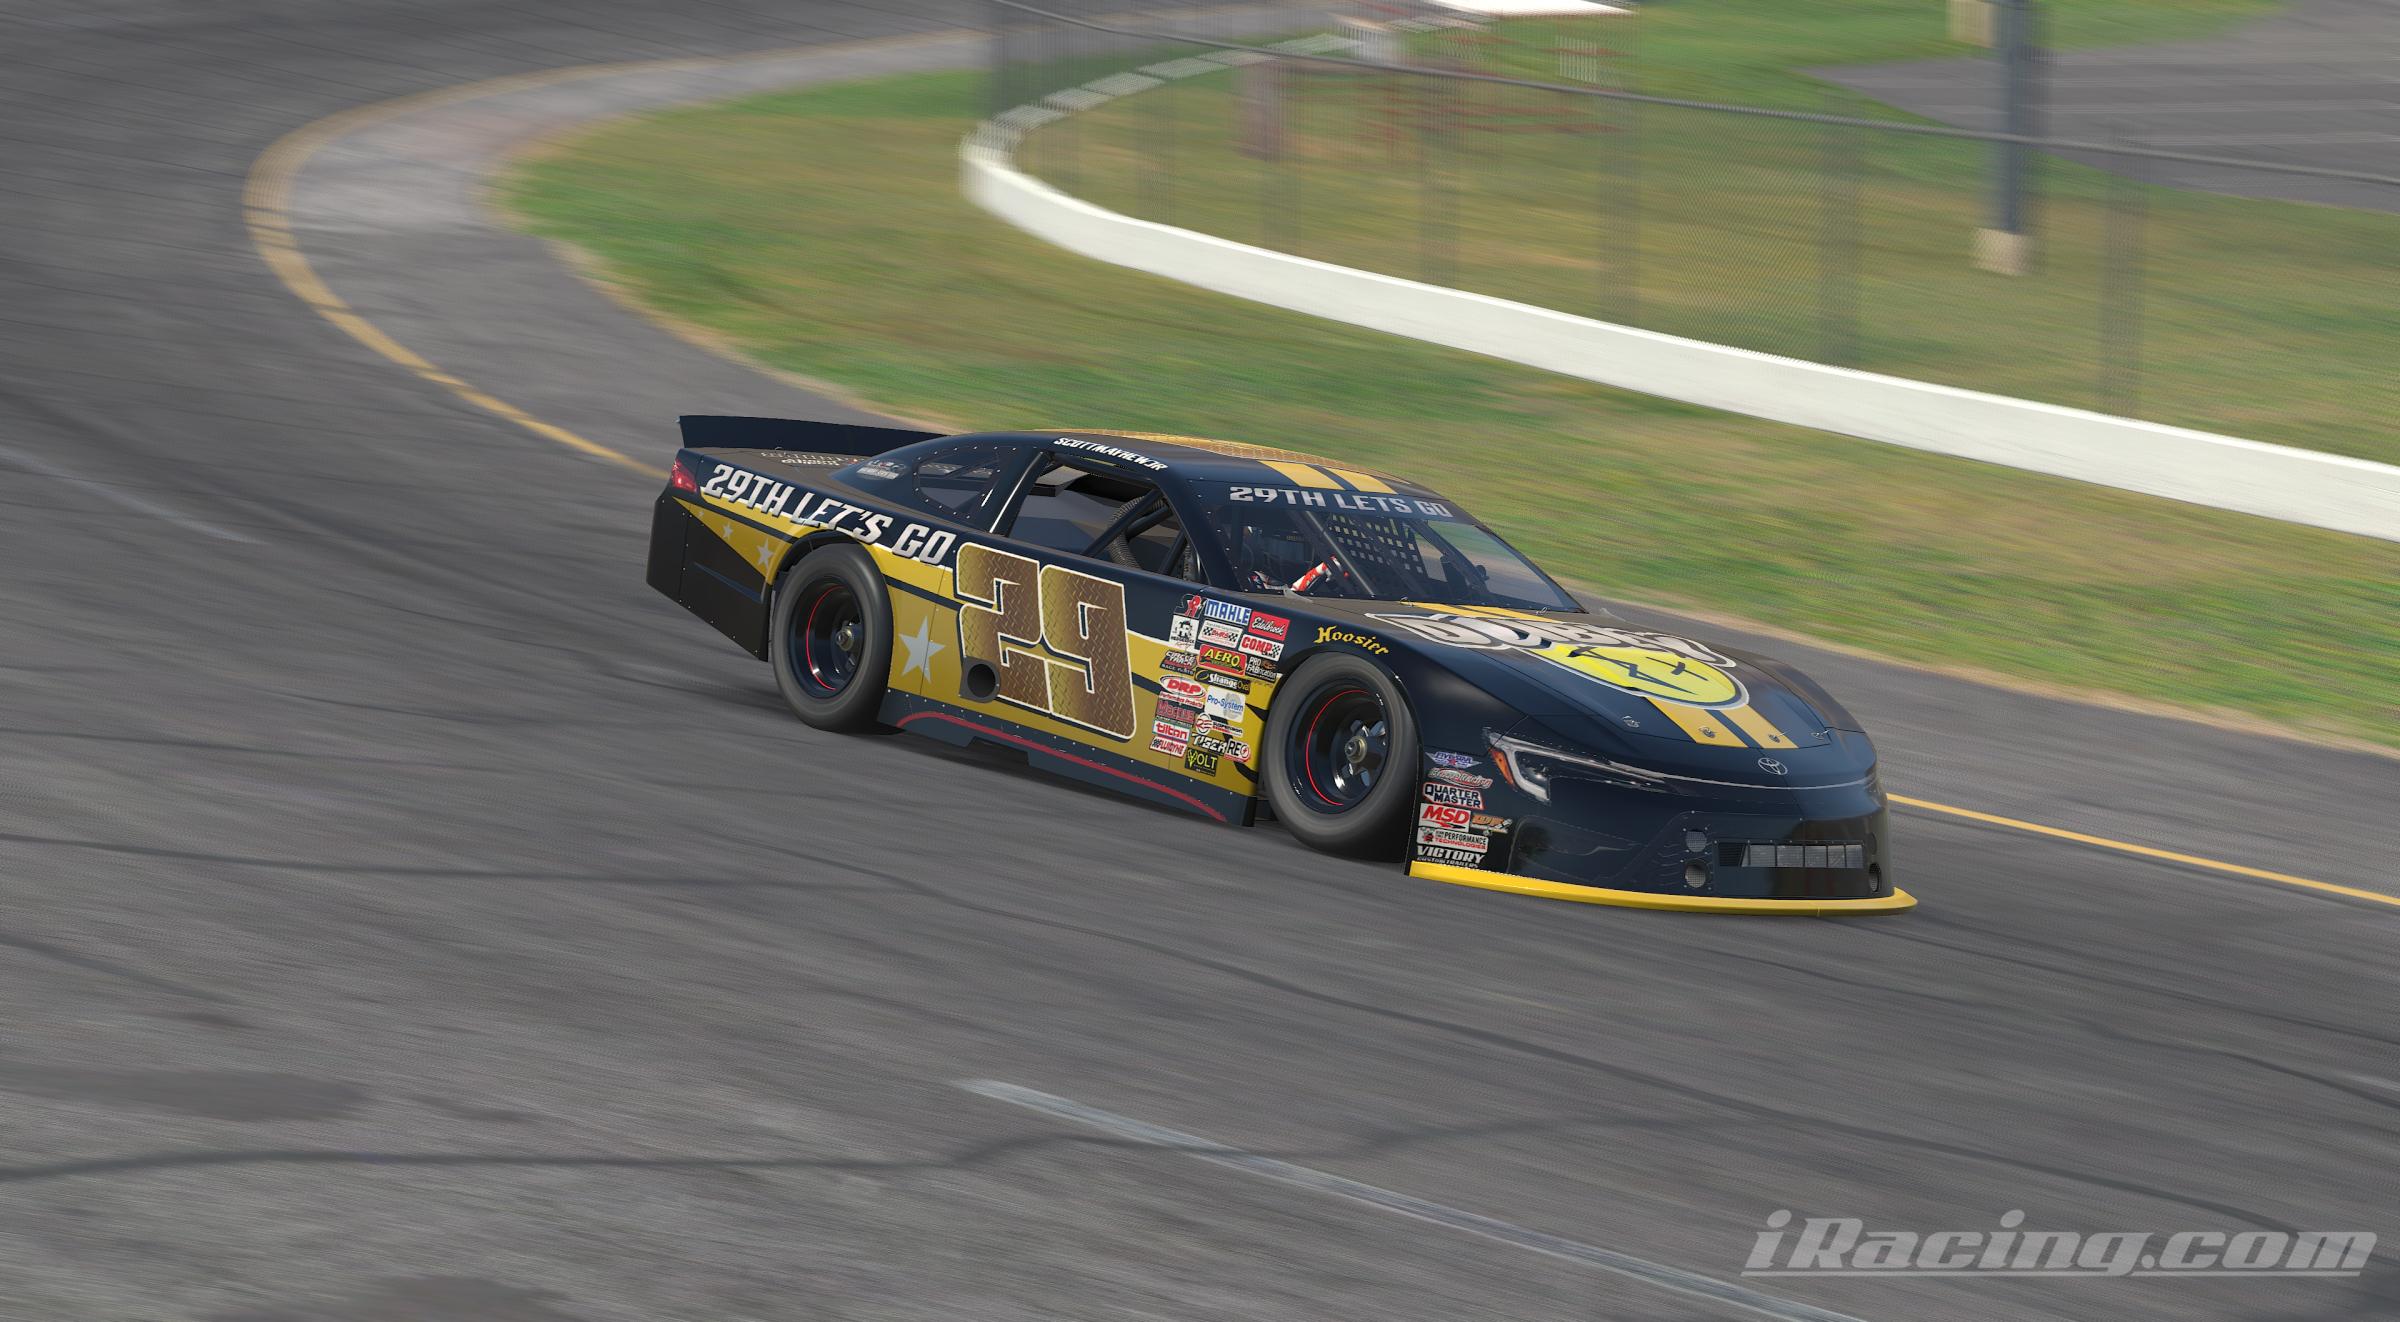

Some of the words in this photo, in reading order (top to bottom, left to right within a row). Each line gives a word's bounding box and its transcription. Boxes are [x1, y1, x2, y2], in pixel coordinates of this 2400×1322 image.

[1230, 486, 1326, 507] 29TH
[1333, 493, 1412, 513] LETS
[1413, 500, 1453, 518] GO
[704, 464, 795, 517] 29TH
[790, 492, 894, 544] LET'S
[892, 523, 957, 564] GO
[1206, 600, 1251, 625] MAHLE
[1252, 616, 1285, 636] Edelbrock
[956, 542, 1136, 739] 29
[1241, 636, 1273, 655] COMP
[1313, 625, 1389, 655] Hoosier
[1204, 648, 1241, 668] AERO
[1249, 656, 1261, 667] PRO
[1167, 678, 1202, 695] DRP
[1208, 673, 1238, 691] Strange
[1206, 694, 1244, 713] Pro-System
[1156, 722, 1188, 740] tilton
[1425, 783, 1480, 800] QUARTER
[1434, 792, 1481, 808] MASTER
[1422, 805, 1470, 824] MSD
[1435, 838, 1487, 850] TECHNOLOGIES
[1444, 831, 1487, 845] PERFORMANCE
[1417, 846, 1486, 863] VICTORY
